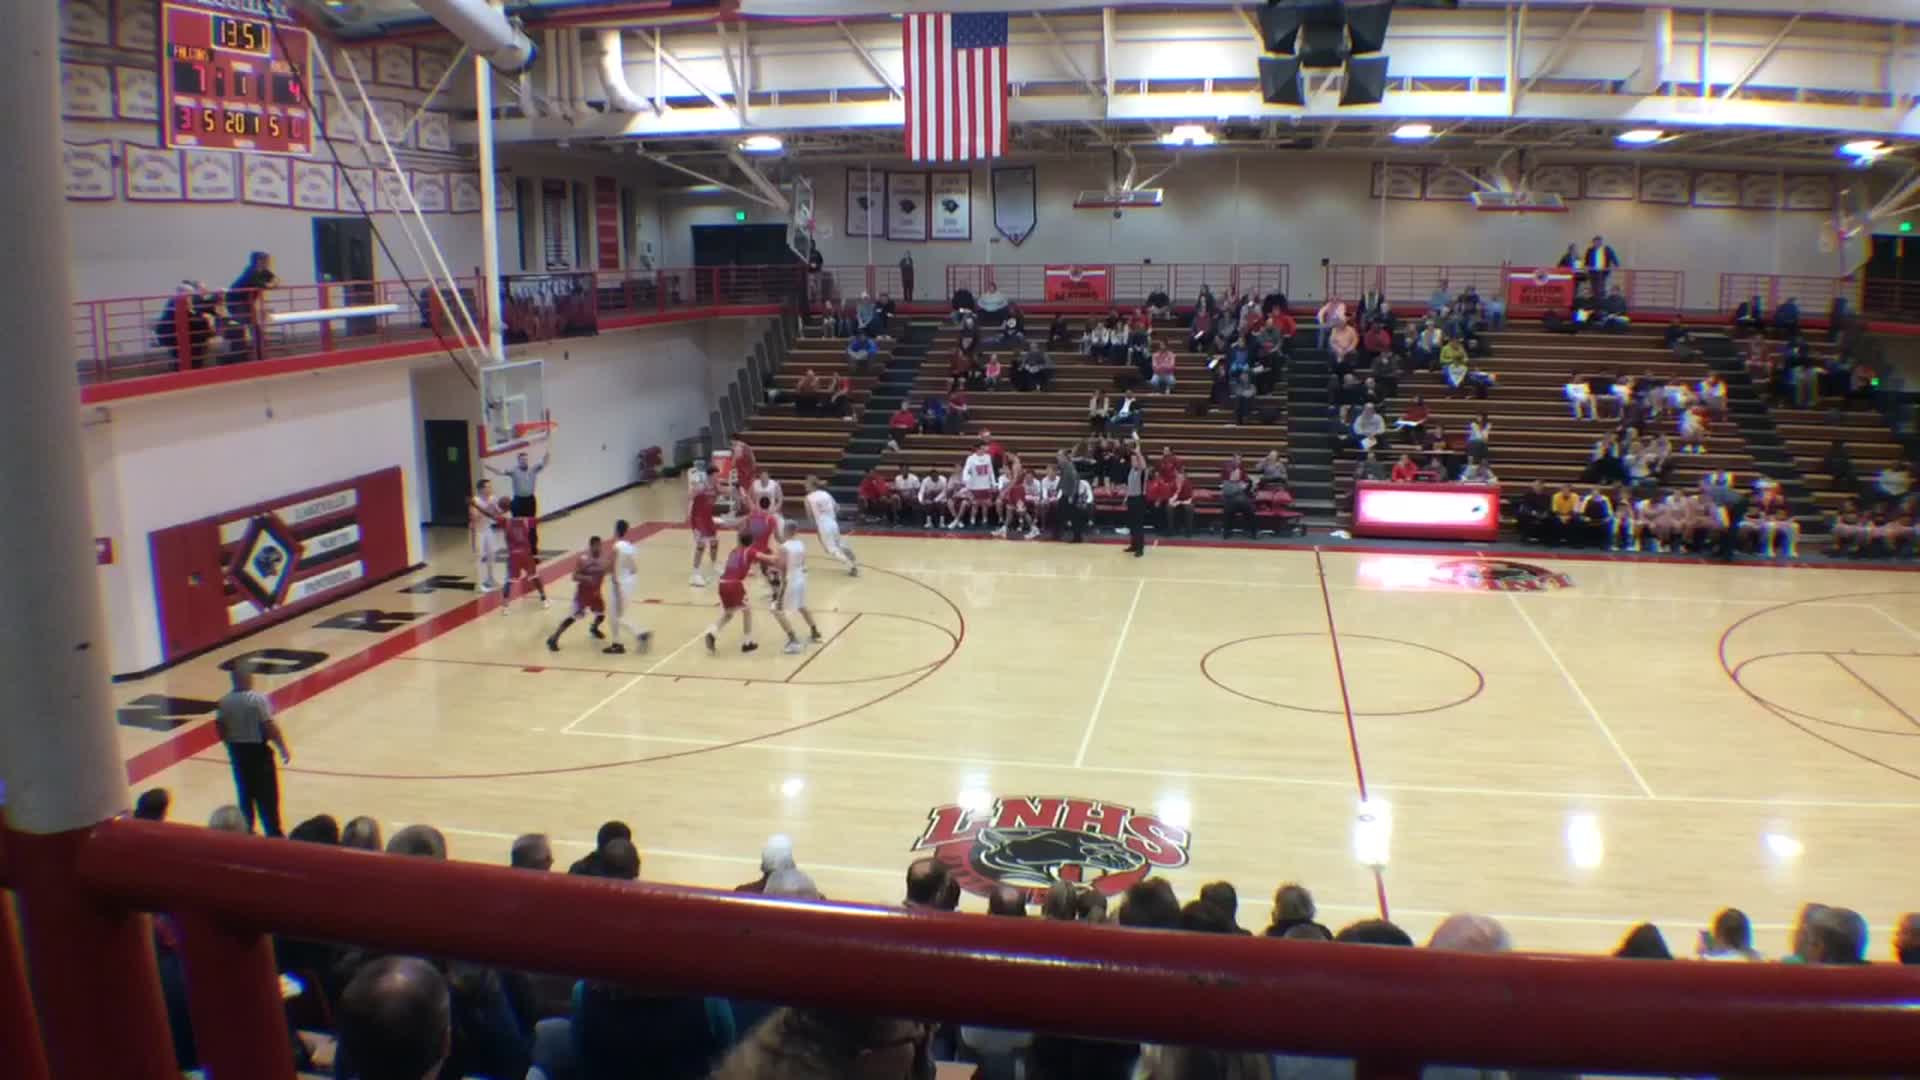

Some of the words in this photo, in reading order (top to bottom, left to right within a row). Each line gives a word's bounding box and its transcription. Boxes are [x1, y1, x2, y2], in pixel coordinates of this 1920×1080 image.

[204, 110, 215, 131] 5
[269, 117, 280, 136] 5
[911, 796, 1190, 869] LNHS
